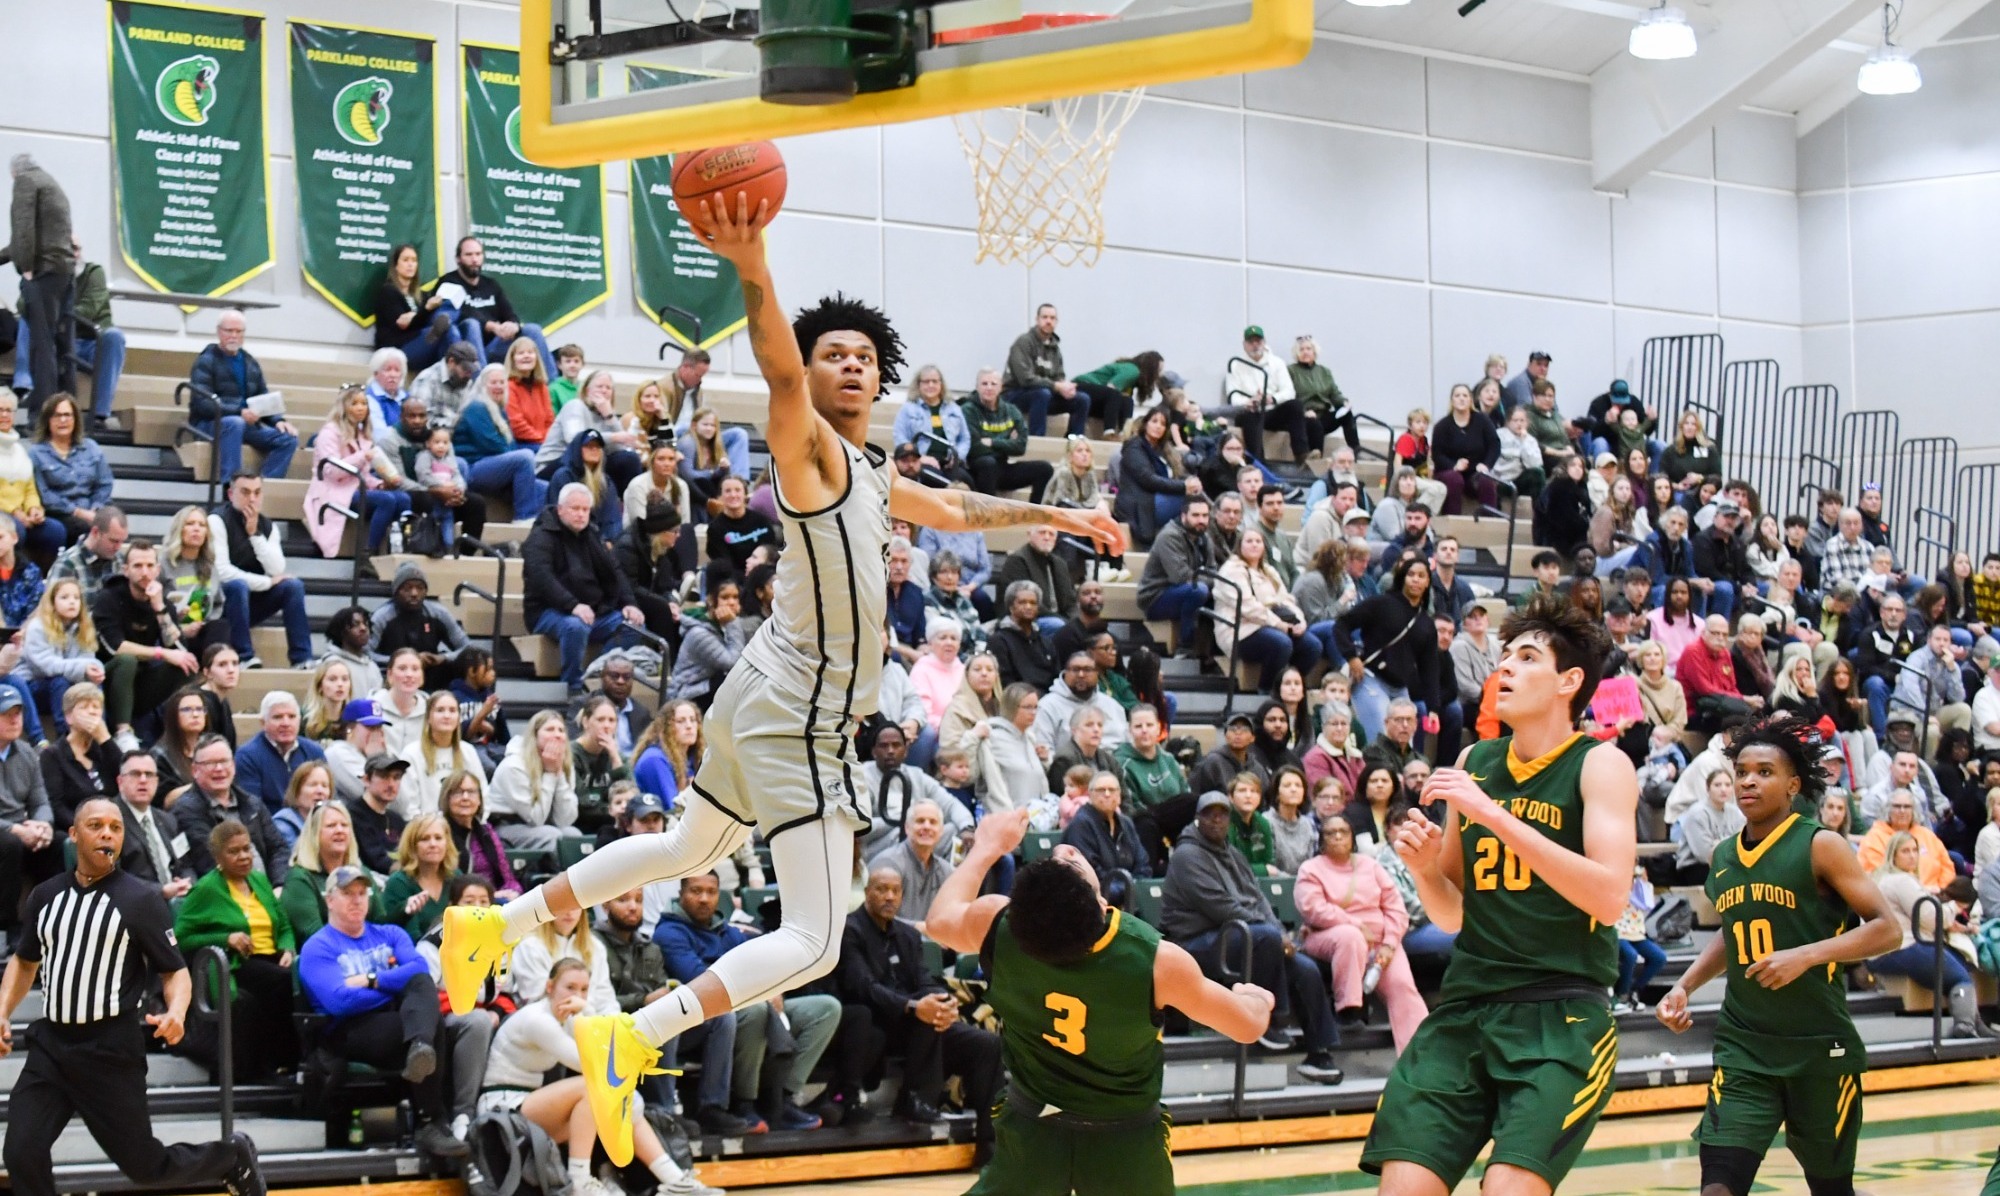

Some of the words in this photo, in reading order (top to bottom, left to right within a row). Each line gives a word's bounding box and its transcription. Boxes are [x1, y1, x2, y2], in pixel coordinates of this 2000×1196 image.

[128, 27, 193, 45] PARKLAND
[194, 34, 246, 51] COLLEGE
[307, 49, 367, 67] PARKLAND
[368, 57, 418, 73] COLLEGE
[480, 71, 520, 86] PARKLA
[136, 129, 176, 144] Athletic
[177, 133, 198, 146] Hall
[199, 136, 212, 147] of
[212, 137, 240, 151] Fame
[155, 148, 183, 162] Class
[184, 151, 196, 163] of
[313, 149, 352, 163] Athletic
[352, 153, 373, 166] Hall
[374, 155, 386, 167] of
[386, 156, 413, 170] Fame
[332, 167, 359, 181] Class
[359, 170, 371, 182] of
[487, 168, 523, 182] Athletic
[525, 171, 543, 184] Hall
[544, 173, 555, 185] of
[556, 174, 581, 188] Fame
[504, 186, 529, 199] Class
[530, 188, 542, 200] of
[1511, 797, 1562, 830] WOOD
[1474, 837, 1531, 890] 20
[1750, 883, 1796, 909] WOOD
[1733, 918, 1774, 964] 10
[1042, 992, 1087, 1055] 3
